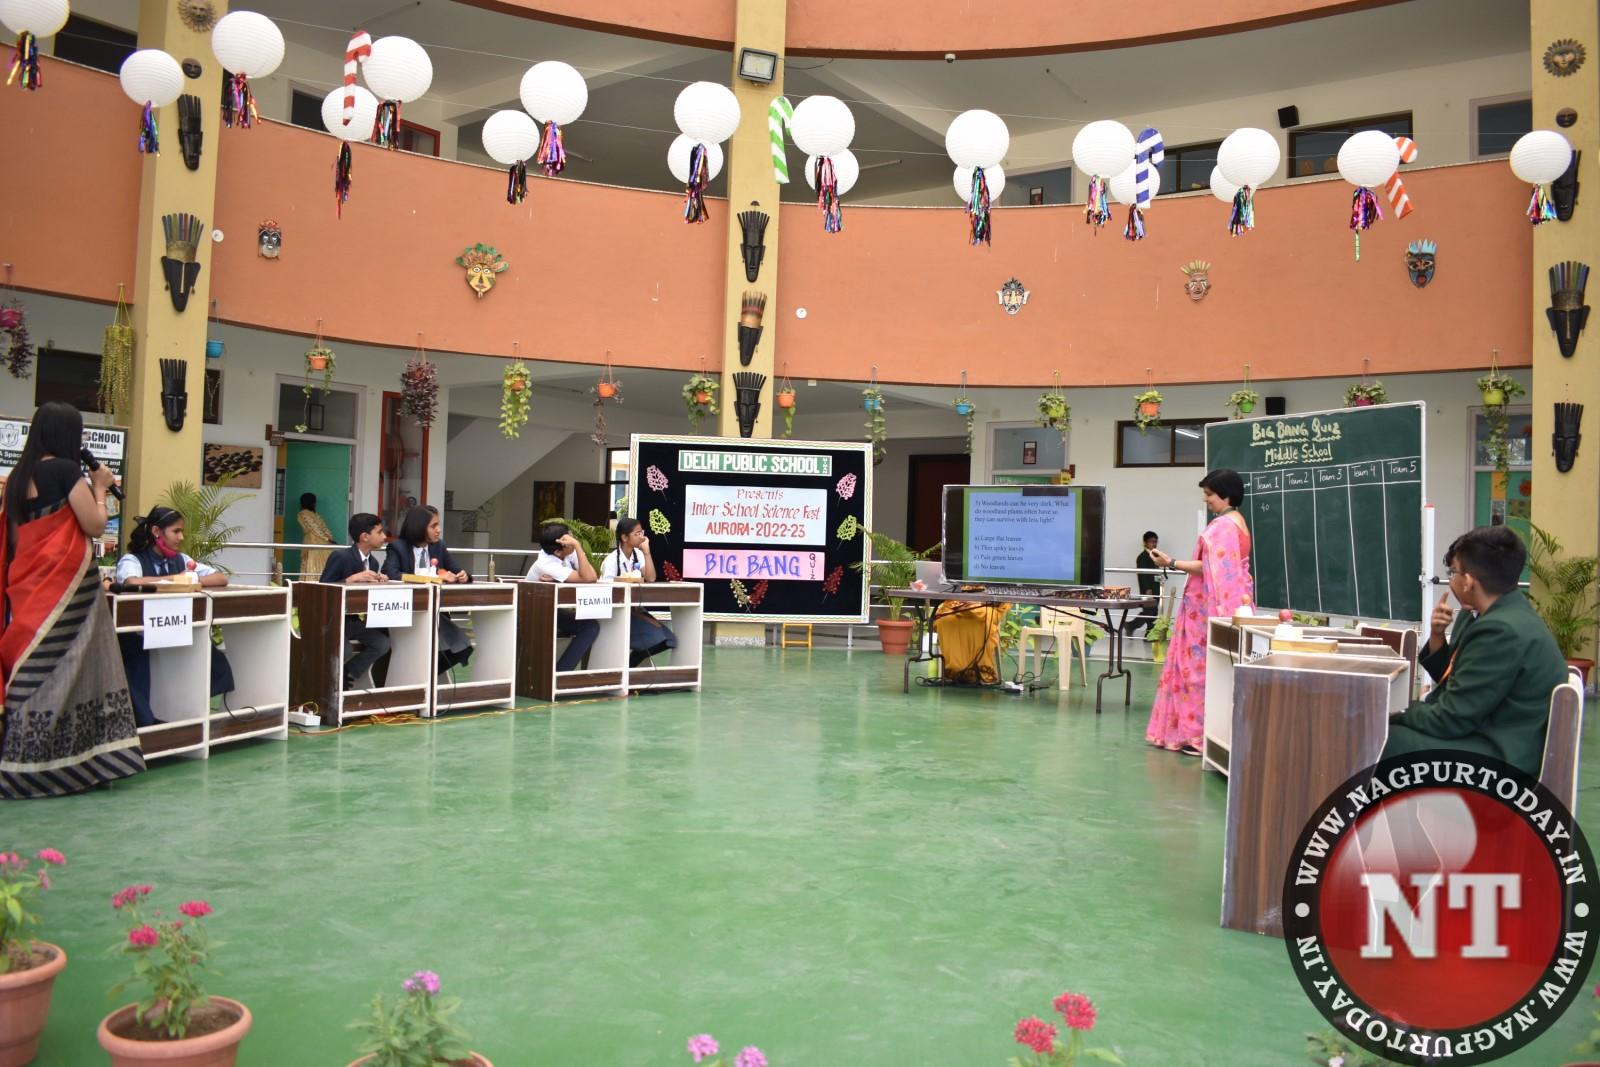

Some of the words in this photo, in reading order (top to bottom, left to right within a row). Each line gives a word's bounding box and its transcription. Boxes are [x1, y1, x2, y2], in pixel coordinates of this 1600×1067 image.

[1278, 420, 1308, 438] BANG
[1265, 446, 1298, 462] Middle
[1302, 444, 1332, 460] School
[684, 452, 720, 470] DELHI
[724, 454, 767, 472] PUBLIC
[771, 456, 820, 474] SCHOOL
[1387, 462, 1408, 474] Team
[1410, 461, 1416, 472] 5
[1317, 470, 1336, 482] Team
[1337, 468, 1342, 480] 3
[1352, 466, 1368, 477] Team
[1370, 464, 1376, 476] 4
[1254, 476, 1272, 490] Team
[1275, 476, 1279, 488] 1
[1286, 474, 1304, 485] Team
[1303, 472, 1308, 483] 2
[737, 488, 784, 500] Presents
[692, 502, 719, 516] Inter
[722, 502, 759, 518] School
[762, 503, 800, 520] Science
[803, 505, 820, 520] Fest
[704, 553, 738, 577] BIG
[747, 555, 801, 577] BANG
[371, 601, 410, 612] TEAM-II
[578, 597, 611, 606] TEAM-III
[149, 615, 187, 628] TEAM-I
